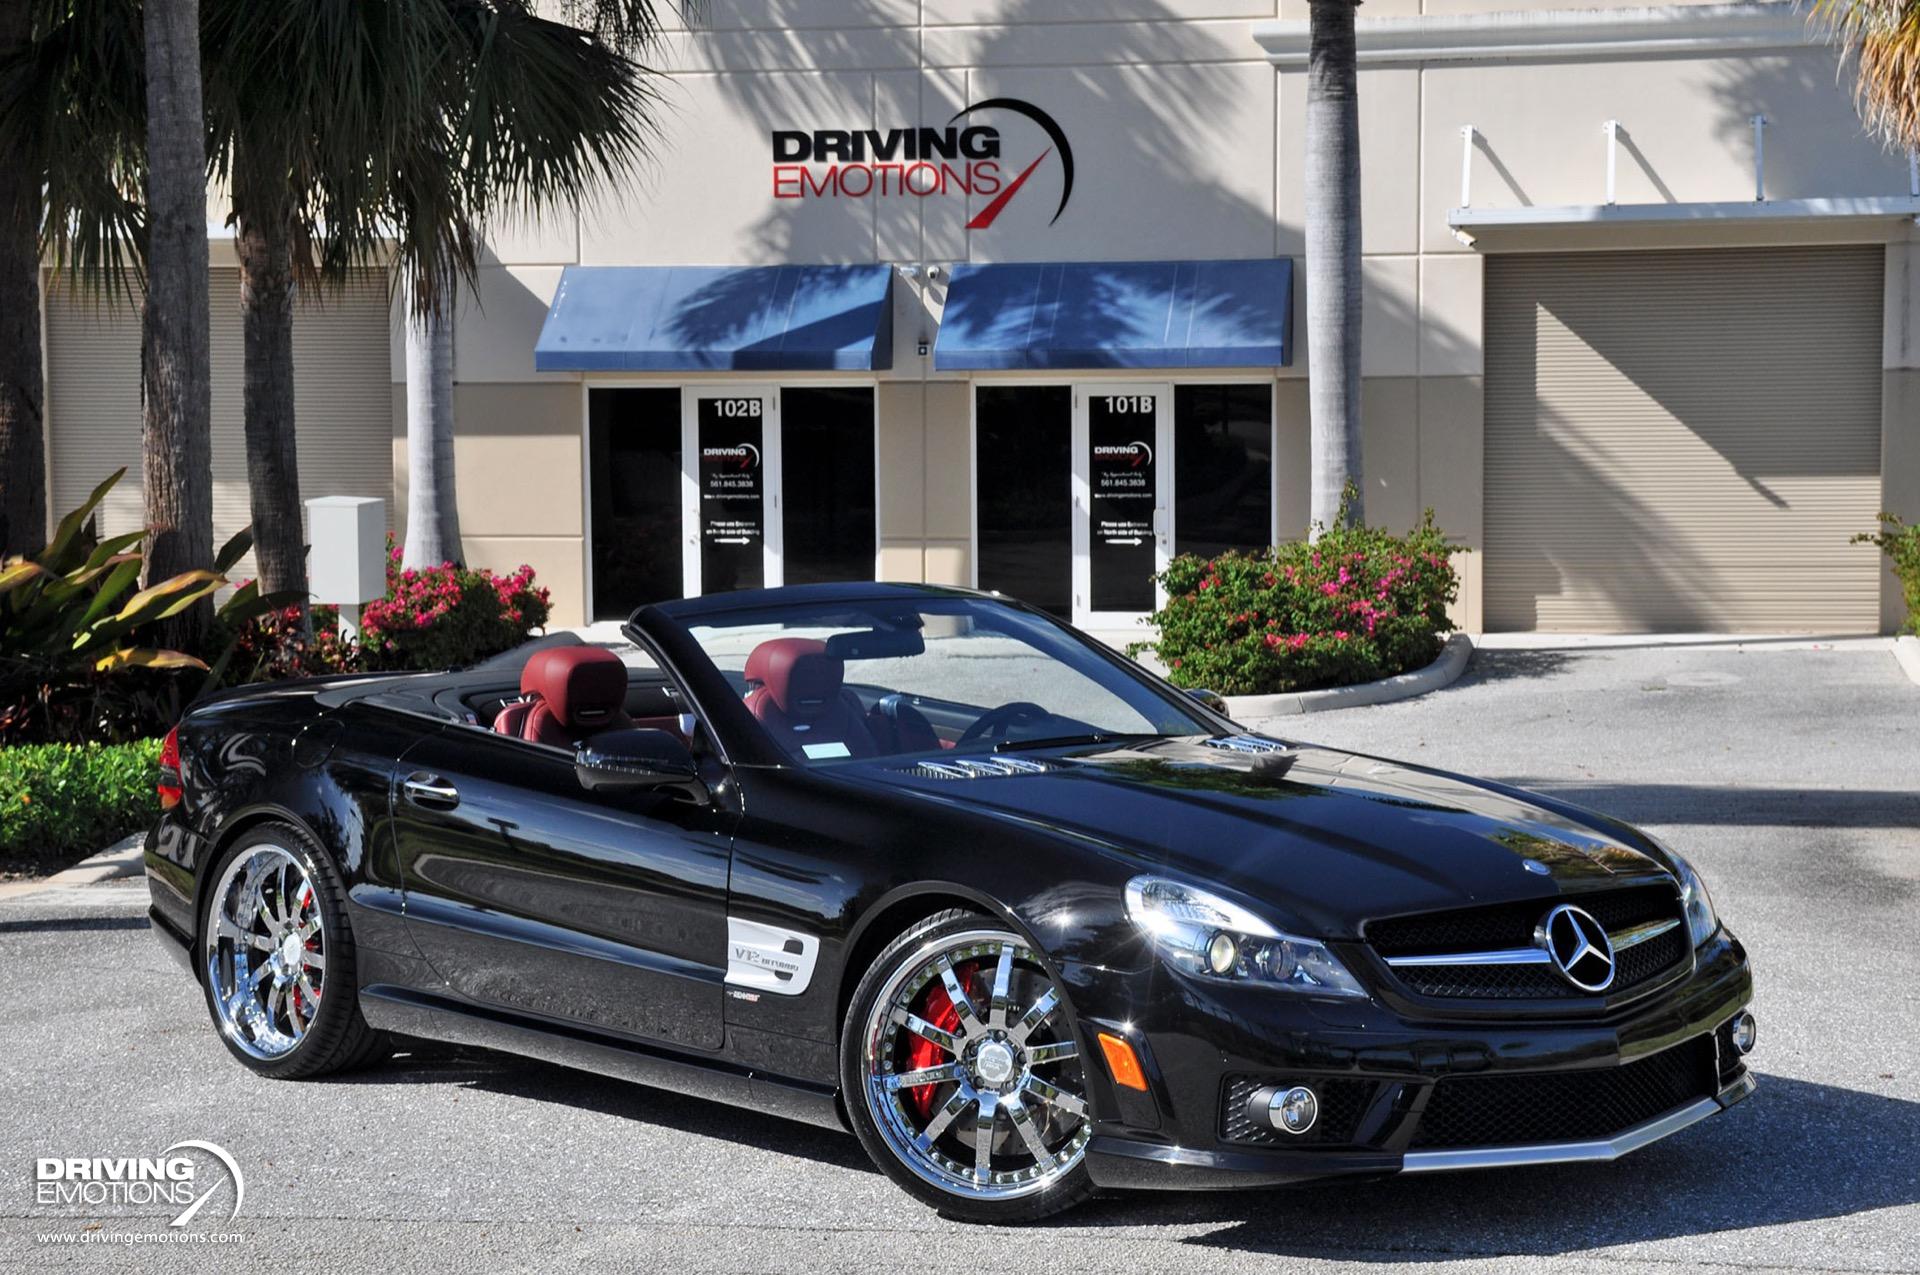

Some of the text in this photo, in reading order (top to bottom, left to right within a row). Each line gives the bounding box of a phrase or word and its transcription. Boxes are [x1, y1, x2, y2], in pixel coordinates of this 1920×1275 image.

[772, 126, 1000, 162] DRIVING
[773, 161, 1001, 198] EMOTIONS
[714, 400, 761, 417] 102B
[1105, 396, 1153, 414] 101B
[703, 448, 747, 456] DRIVING
[1094, 446, 1139, 454] DRIVING
